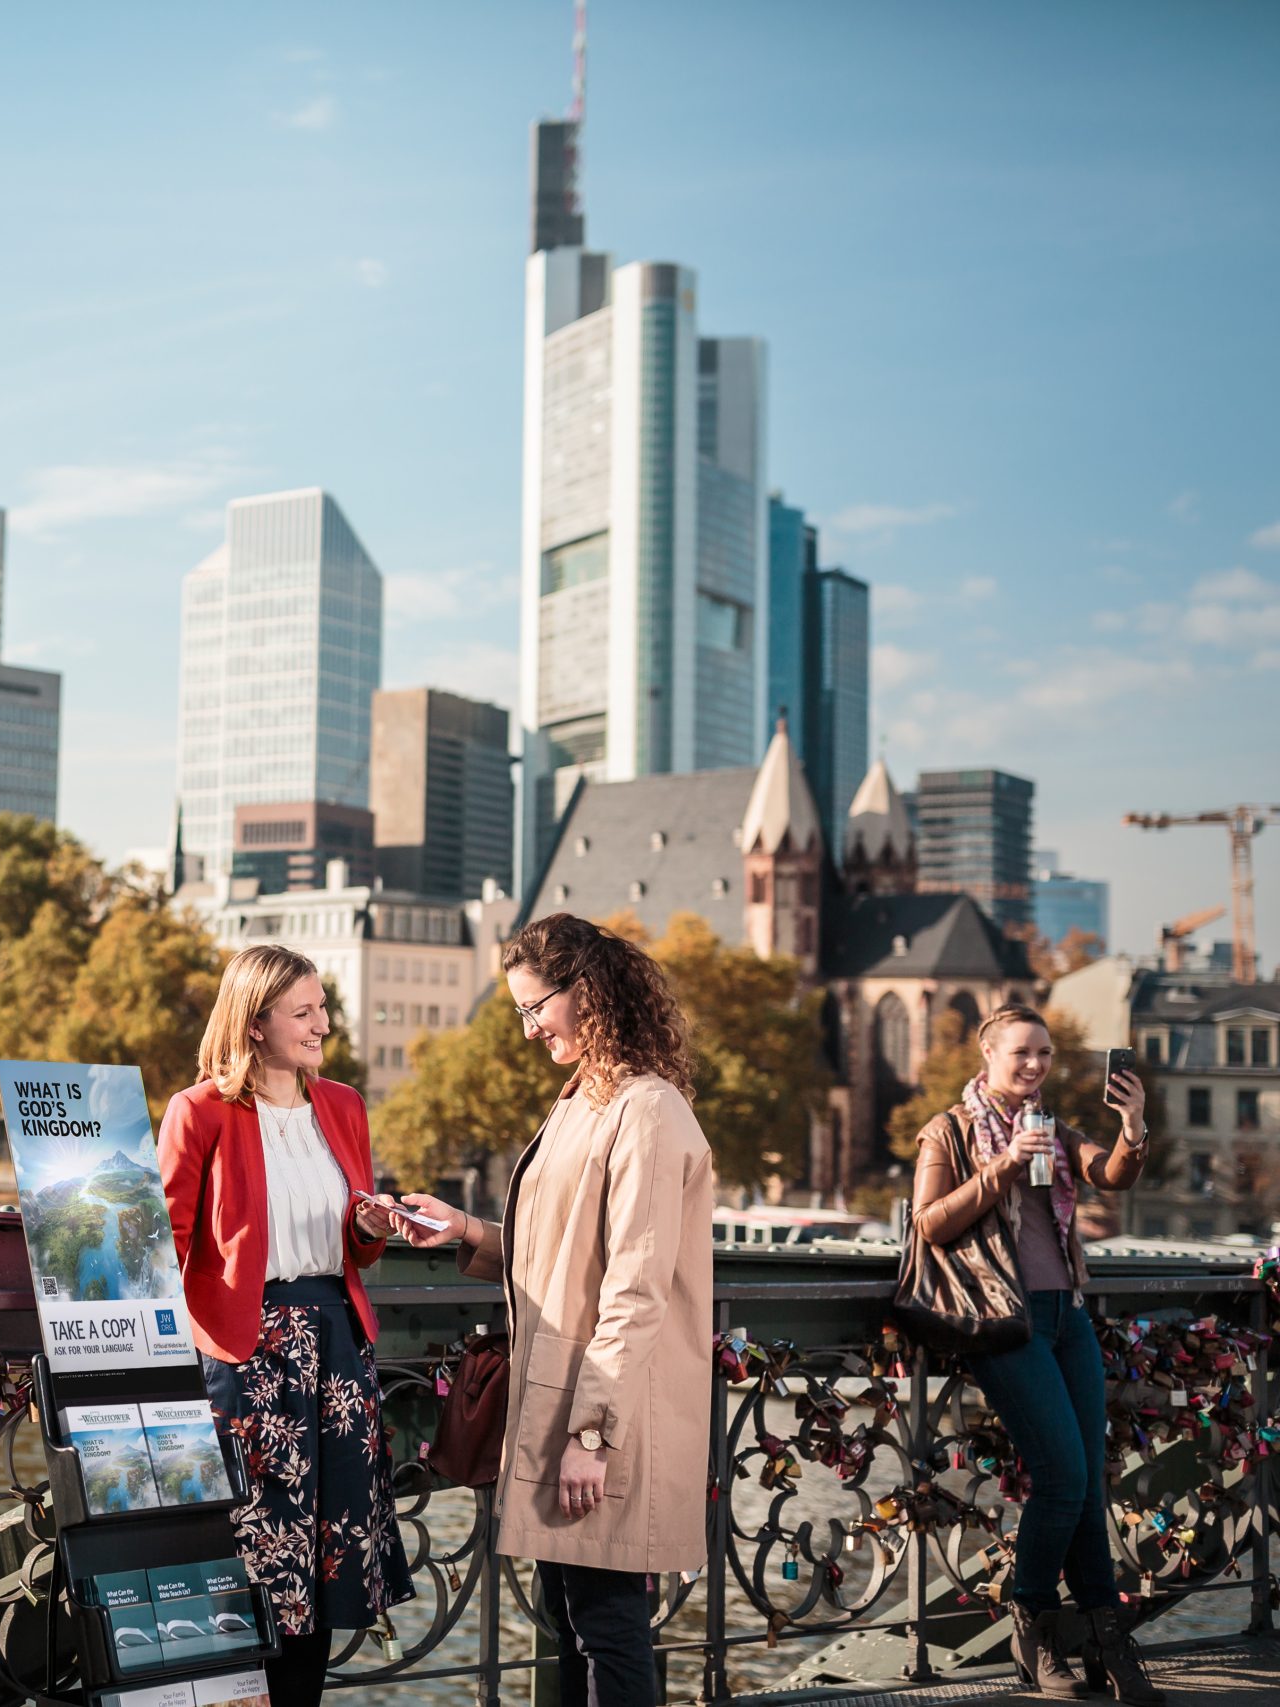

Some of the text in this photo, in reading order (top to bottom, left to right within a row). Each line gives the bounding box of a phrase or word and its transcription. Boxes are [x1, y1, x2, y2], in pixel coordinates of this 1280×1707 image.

[14, 1081, 82, 1100] WHAT IS
[18, 1100, 67, 1118] GOD'S
[22, 1119, 102, 1138] KINGDOM?
[160, 1313, 171, 1324] JW
[49, 1318, 136, 1340] TAKE A COPY
[54, 1343, 134, 1356] ASK FOR YOUR LANGUAGE
[82, 1414, 130, 1422] WATCHTOWER
[246, 1678, 259, 1686] Family
